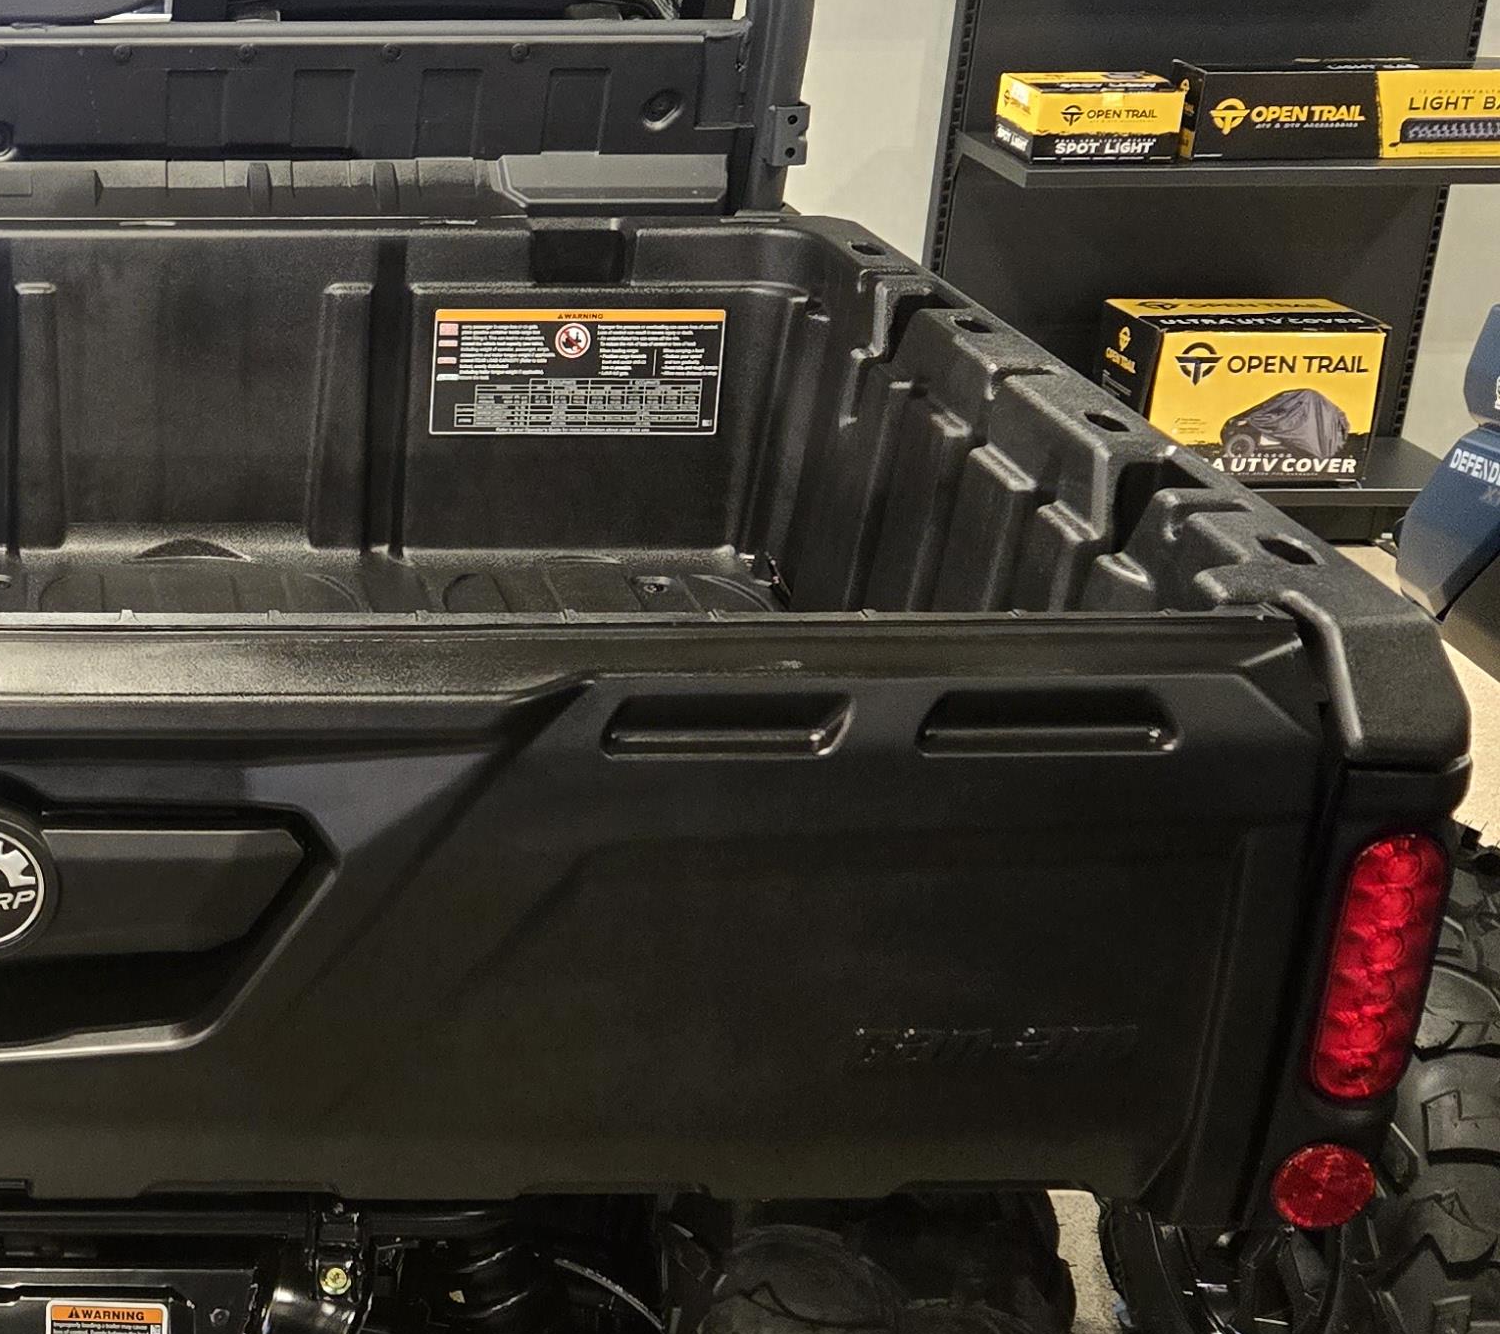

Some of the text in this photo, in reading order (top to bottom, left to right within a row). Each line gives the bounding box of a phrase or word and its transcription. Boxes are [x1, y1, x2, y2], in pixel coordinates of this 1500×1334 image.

[1408, 95, 1500, 111] LIGHT B
[1086, 109, 1158, 119] OPEN TRAIL
[1251, 105, 1366, 123] OPEN TRAIL
[1054, 142, 1155, 155] SPOT LIGHT
[1288, 317, 1365, 325] COVER
[1227, 355, 1369, 374] OPEN TRAIL
[1230, 458, 1279, 472] UTV
[1281, 457, 1357, 473] COVER
[81, 1309, 145, 1321] WARNING
